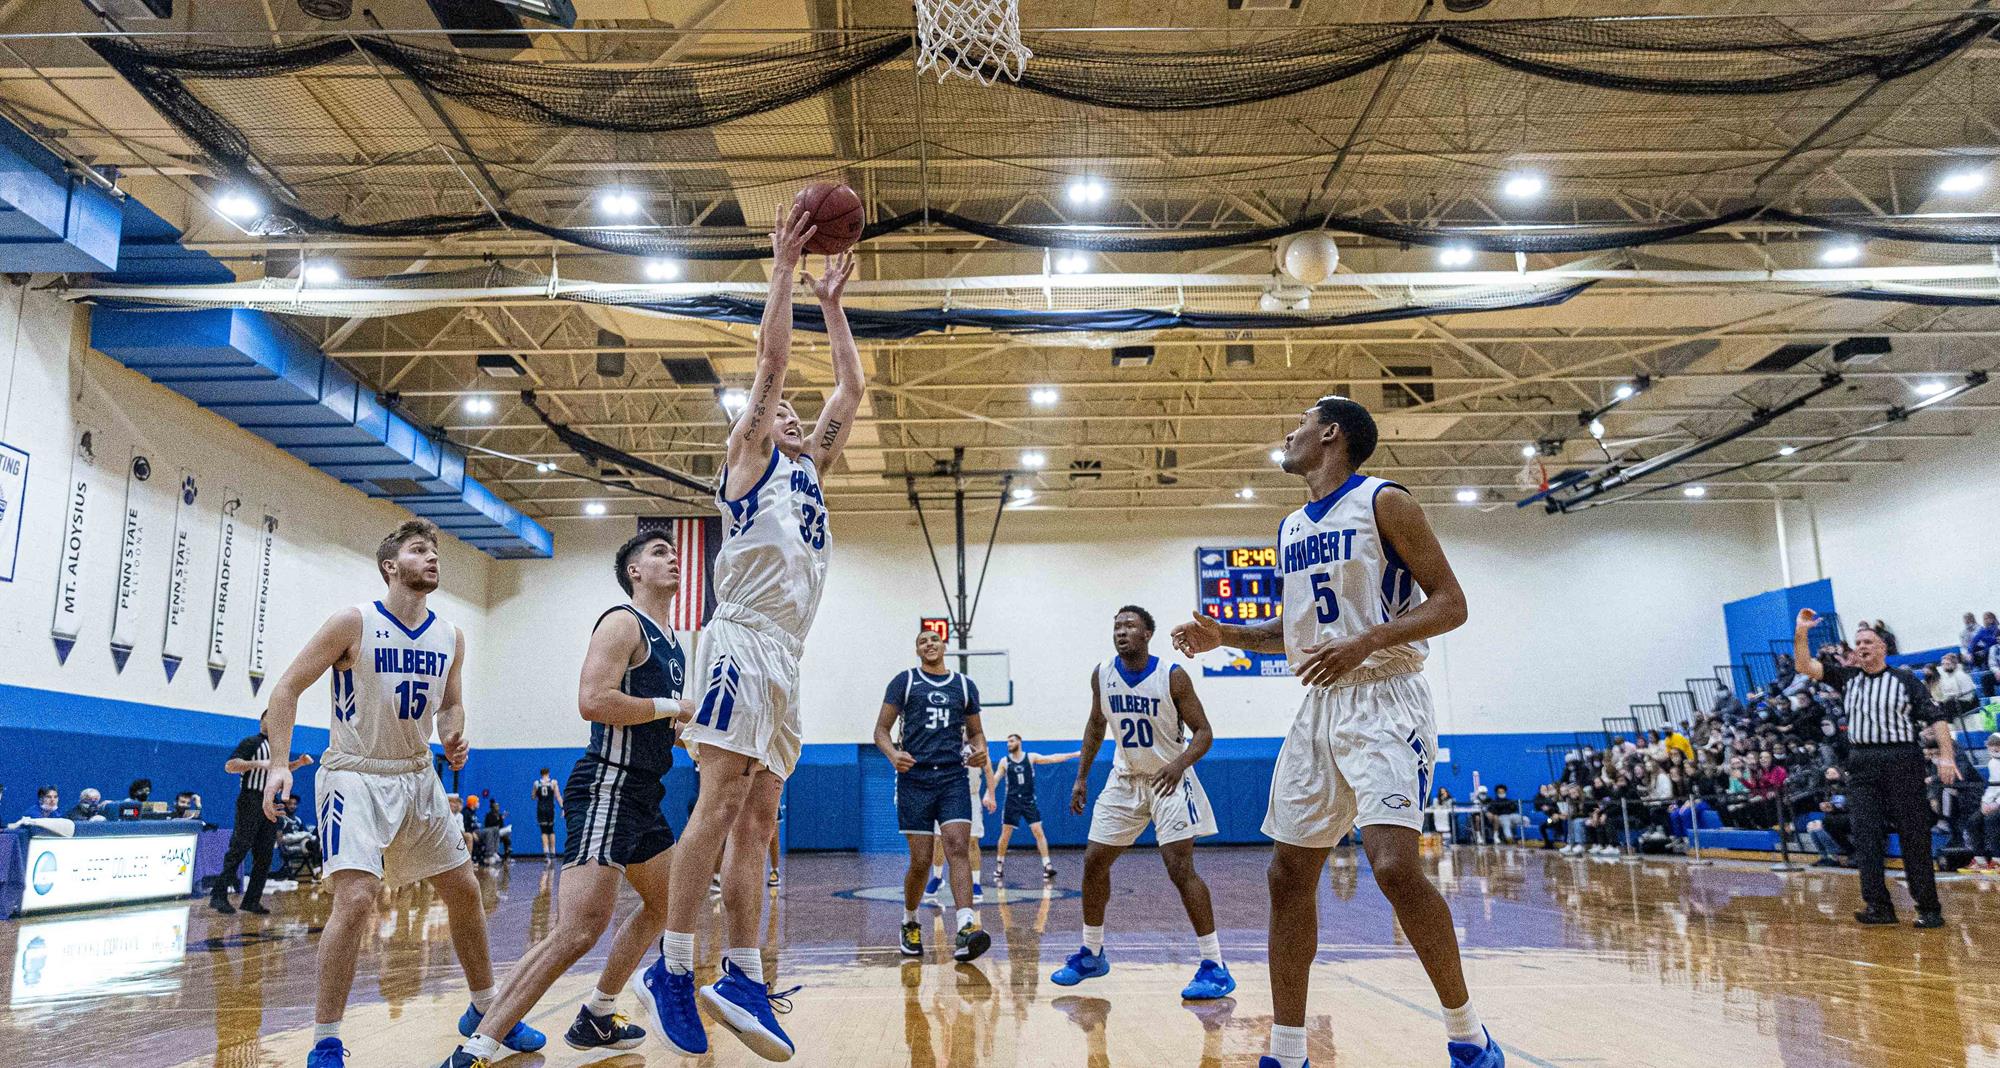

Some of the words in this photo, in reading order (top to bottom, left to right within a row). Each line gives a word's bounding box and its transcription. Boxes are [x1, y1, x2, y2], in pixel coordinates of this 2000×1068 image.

[68, 481, 87, 576] ALOYSIUS
[125, 508, 138, 559] STATE
[175, 530, 188, 578] STATE
[1232, 547, 1277, 568] 12:49
[64, 581, 76, 614] MT.
[121, 562, 132, 609] PENN
[215, 523, 234, 655] PITT-BRADFORD
[256, 536, 273, 670] PITT-GREENSBURG
[1218, 578, 1232, 598] 6
[1251, 580, 1259, 595] 1
[1309, 571, 1340, 625] 5
[171, 582, 182, 626] PENN
[1208, 604, 1219, 618] 4
[1238, 602, 1258, 619] 33
[374, 647, 448, 678] HILBERT
[395, 680, 430, 720] 15
[925, 707, 950, 730] 34
[1120, 718, 1154, 748] 20
